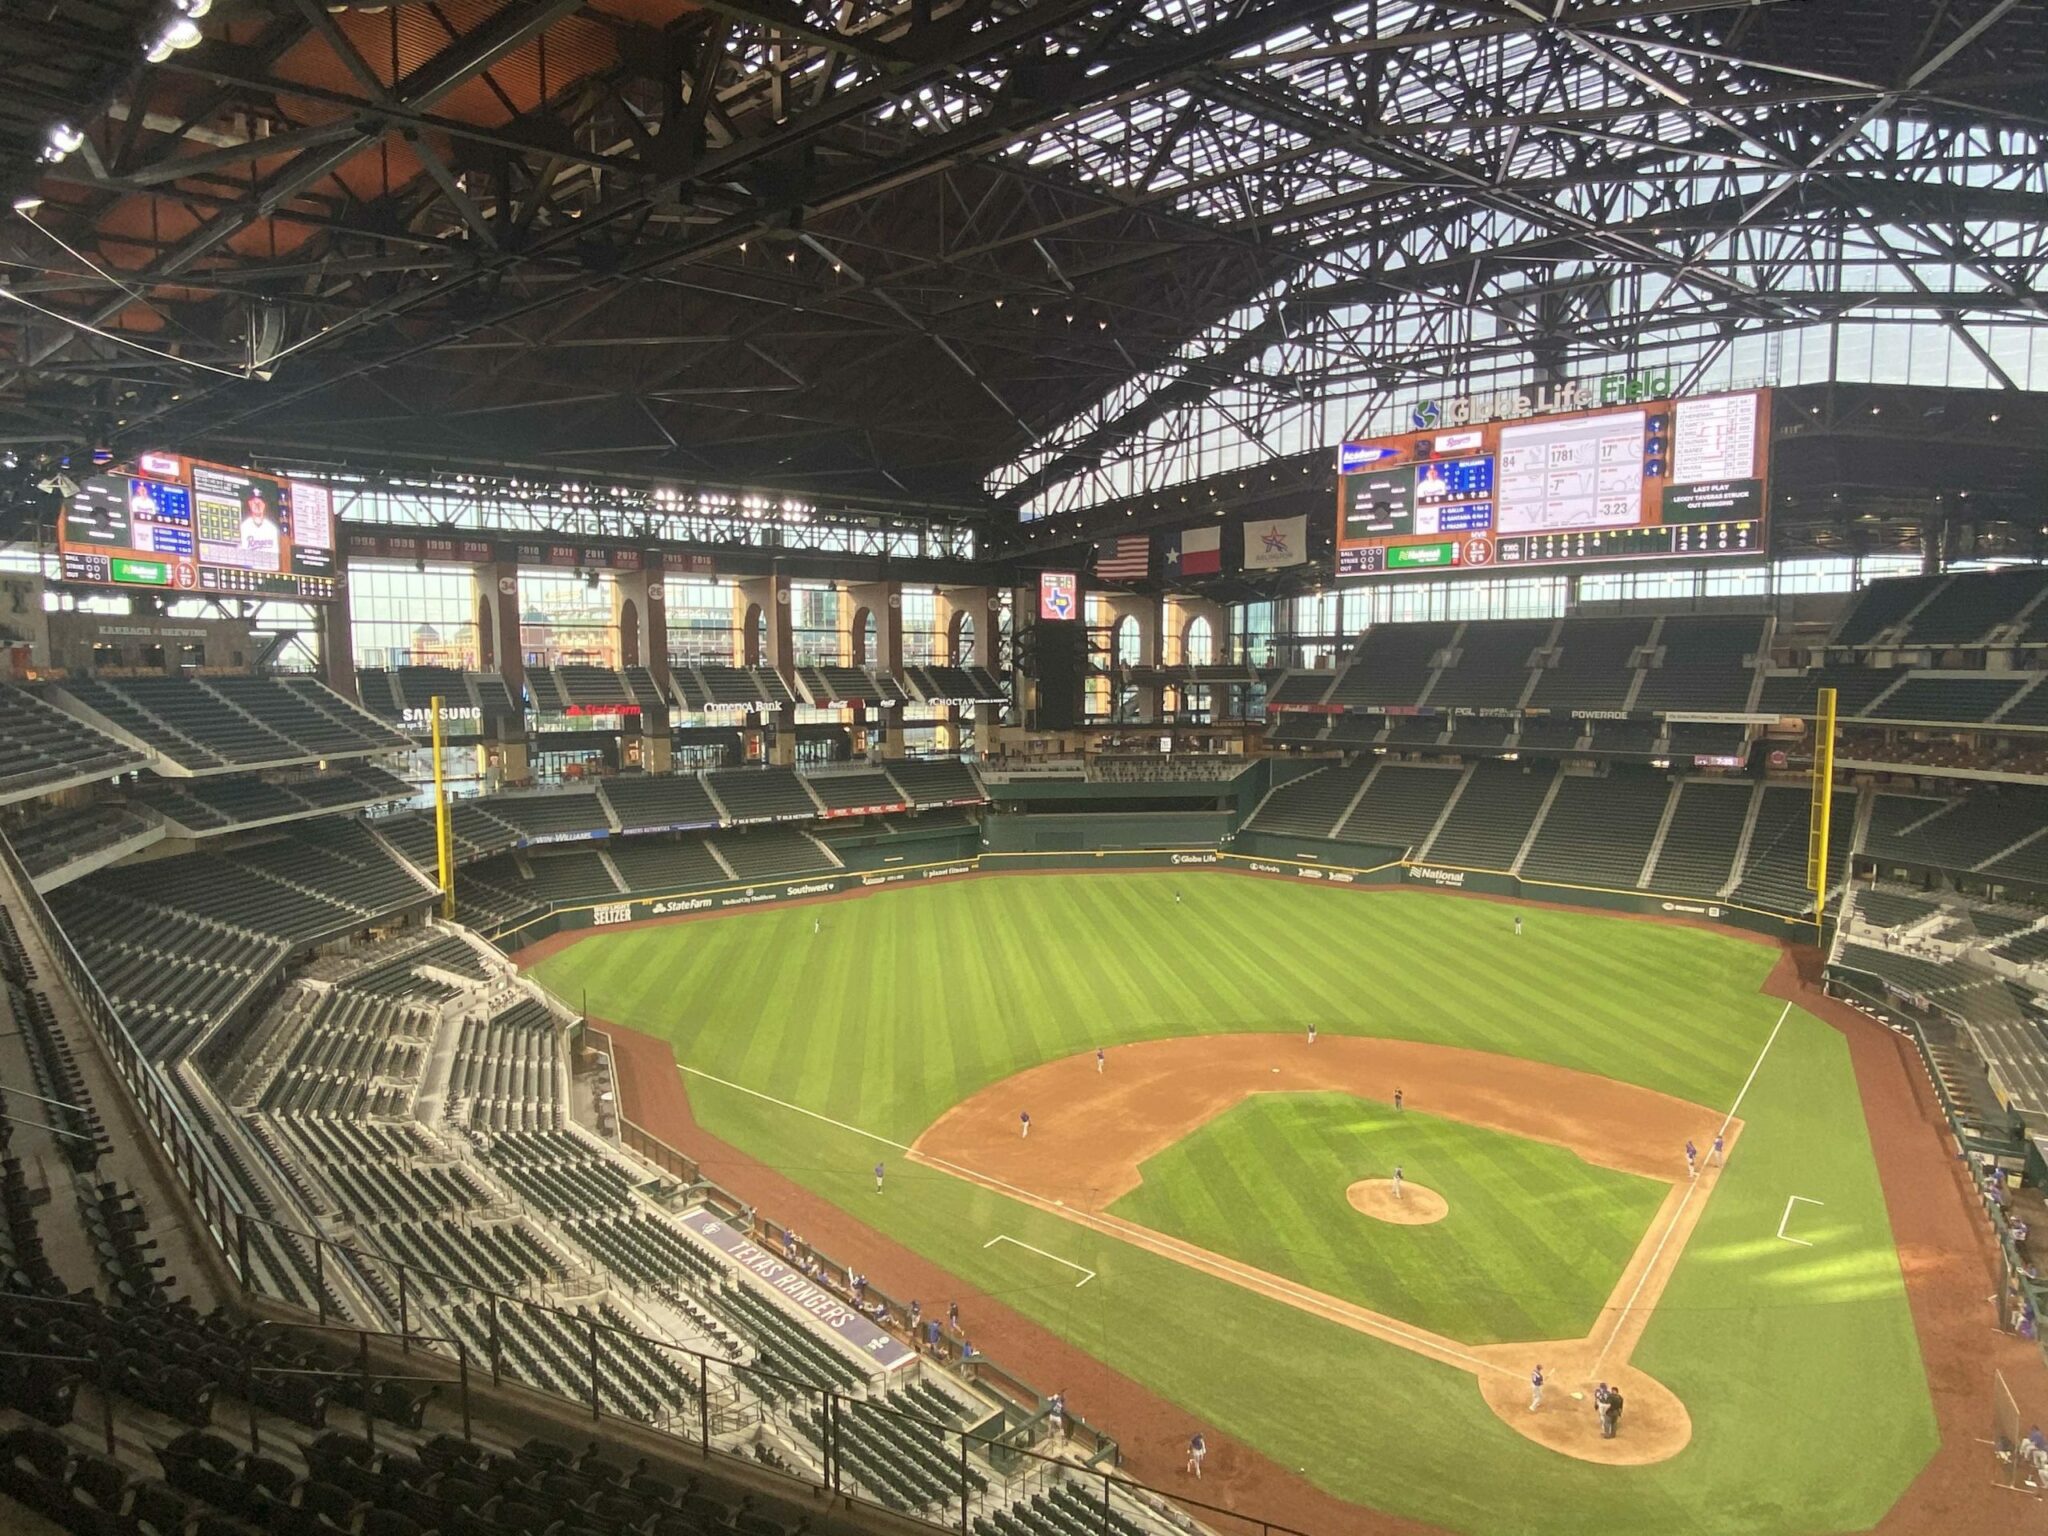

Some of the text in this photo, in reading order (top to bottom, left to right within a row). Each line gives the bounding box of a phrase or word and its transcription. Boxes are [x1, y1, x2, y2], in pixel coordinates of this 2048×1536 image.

[1449, 366, 1671, 423] Globe Life Field
[1551, 449, 1573, 462] 1781
[1503, 455, 1515, 468] 84
[1693, 484, 1730, 493] LAST PLAY
[1719, 531, 1727, 539] 0
[464, 542, 488, 551] 2010
[1502, 544, 1520, 552] TXC
[1531, 542, 1538, 550] 0
[1546, 542, 1553, 550] 0
[1561, 541, 1568, 549] 0
[1593, 538, 1600, 547] 0
[1719, 540, 1727, 548] 0
[518, 545, 539, 555] 2010
[553, 547, 573, 557] 2011
[585, 549, 605, 559] 2011
[1546, 550, 1553, 558] 0
[1561, 549, 1568, 557] 0
[1577, 548, 1584, 556] 0
[617, 551, 638, 560] 2012
[1340, 557, 1358, 565] STRIKE
[501, 580, 516, 590] 34
[650, 586, 662, 596] 26
[161, 627, 207, 637] BREWING
[755, 700, 783, 712] Bank
[1571, 710, 1628, 720] POWERADE
[1181, 854, 1217, 863] Globe Life
[1421, 867, 1465, 881] National
[787, 883, 829, 896] Southwest
[593, 908, 632, 925] SELTZER
[727, 1240, 855, 1328] TEXAS RANGERS
